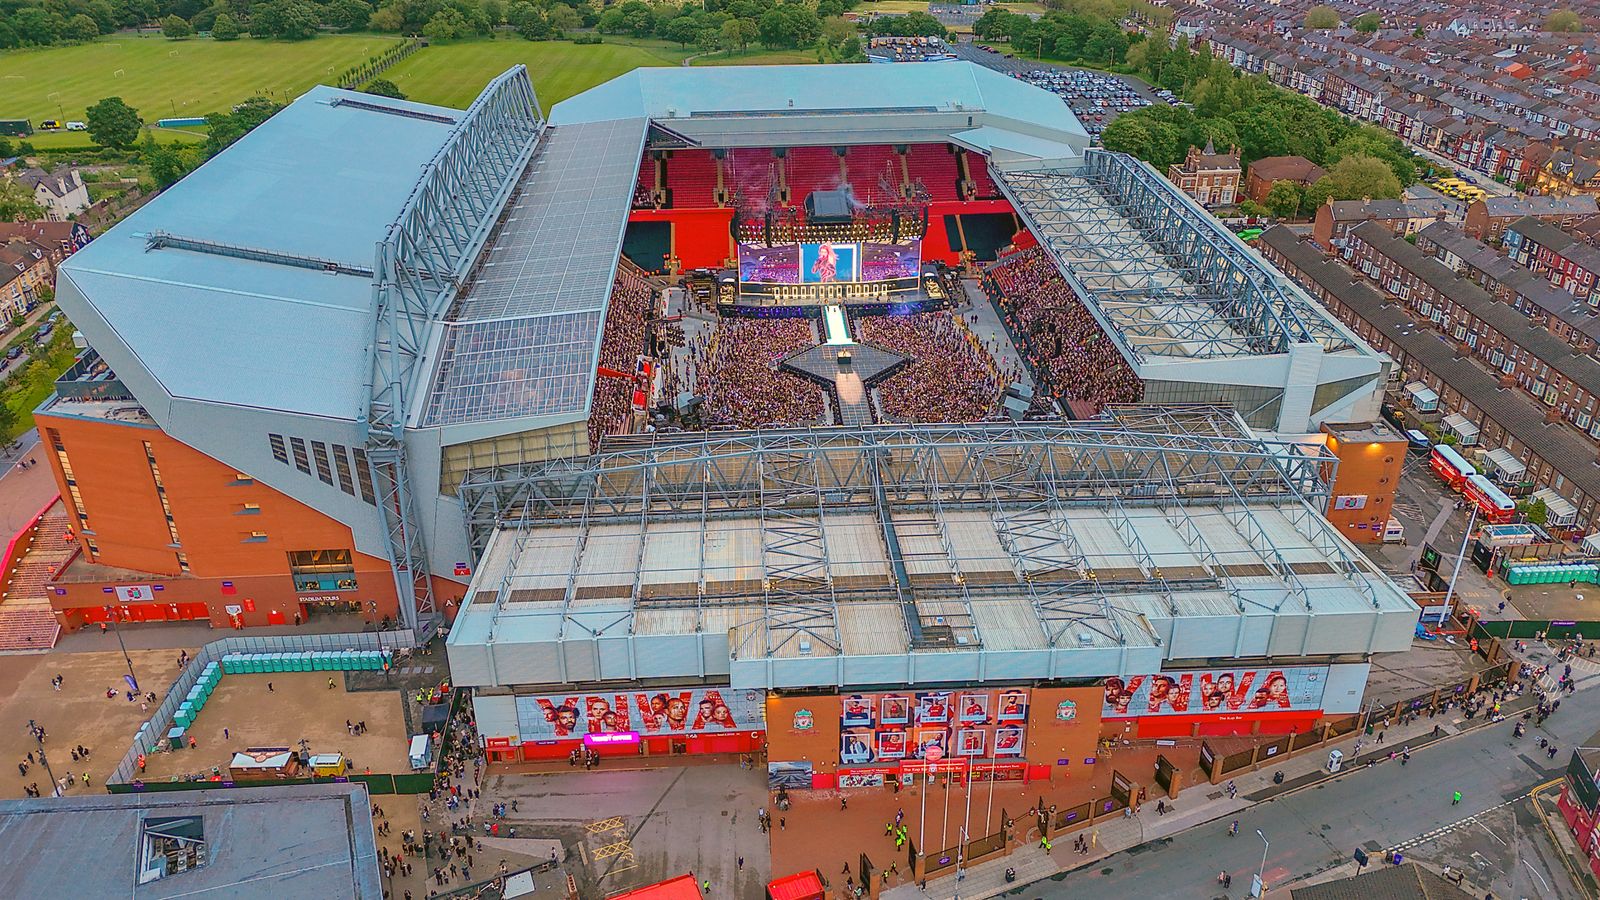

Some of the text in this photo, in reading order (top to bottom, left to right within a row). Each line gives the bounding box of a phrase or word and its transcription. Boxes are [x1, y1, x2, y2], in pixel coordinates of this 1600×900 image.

[445, 599, 453, 607] A
[535, 689, 737, 735] YNWA
[750, 731, 758, 739] C
